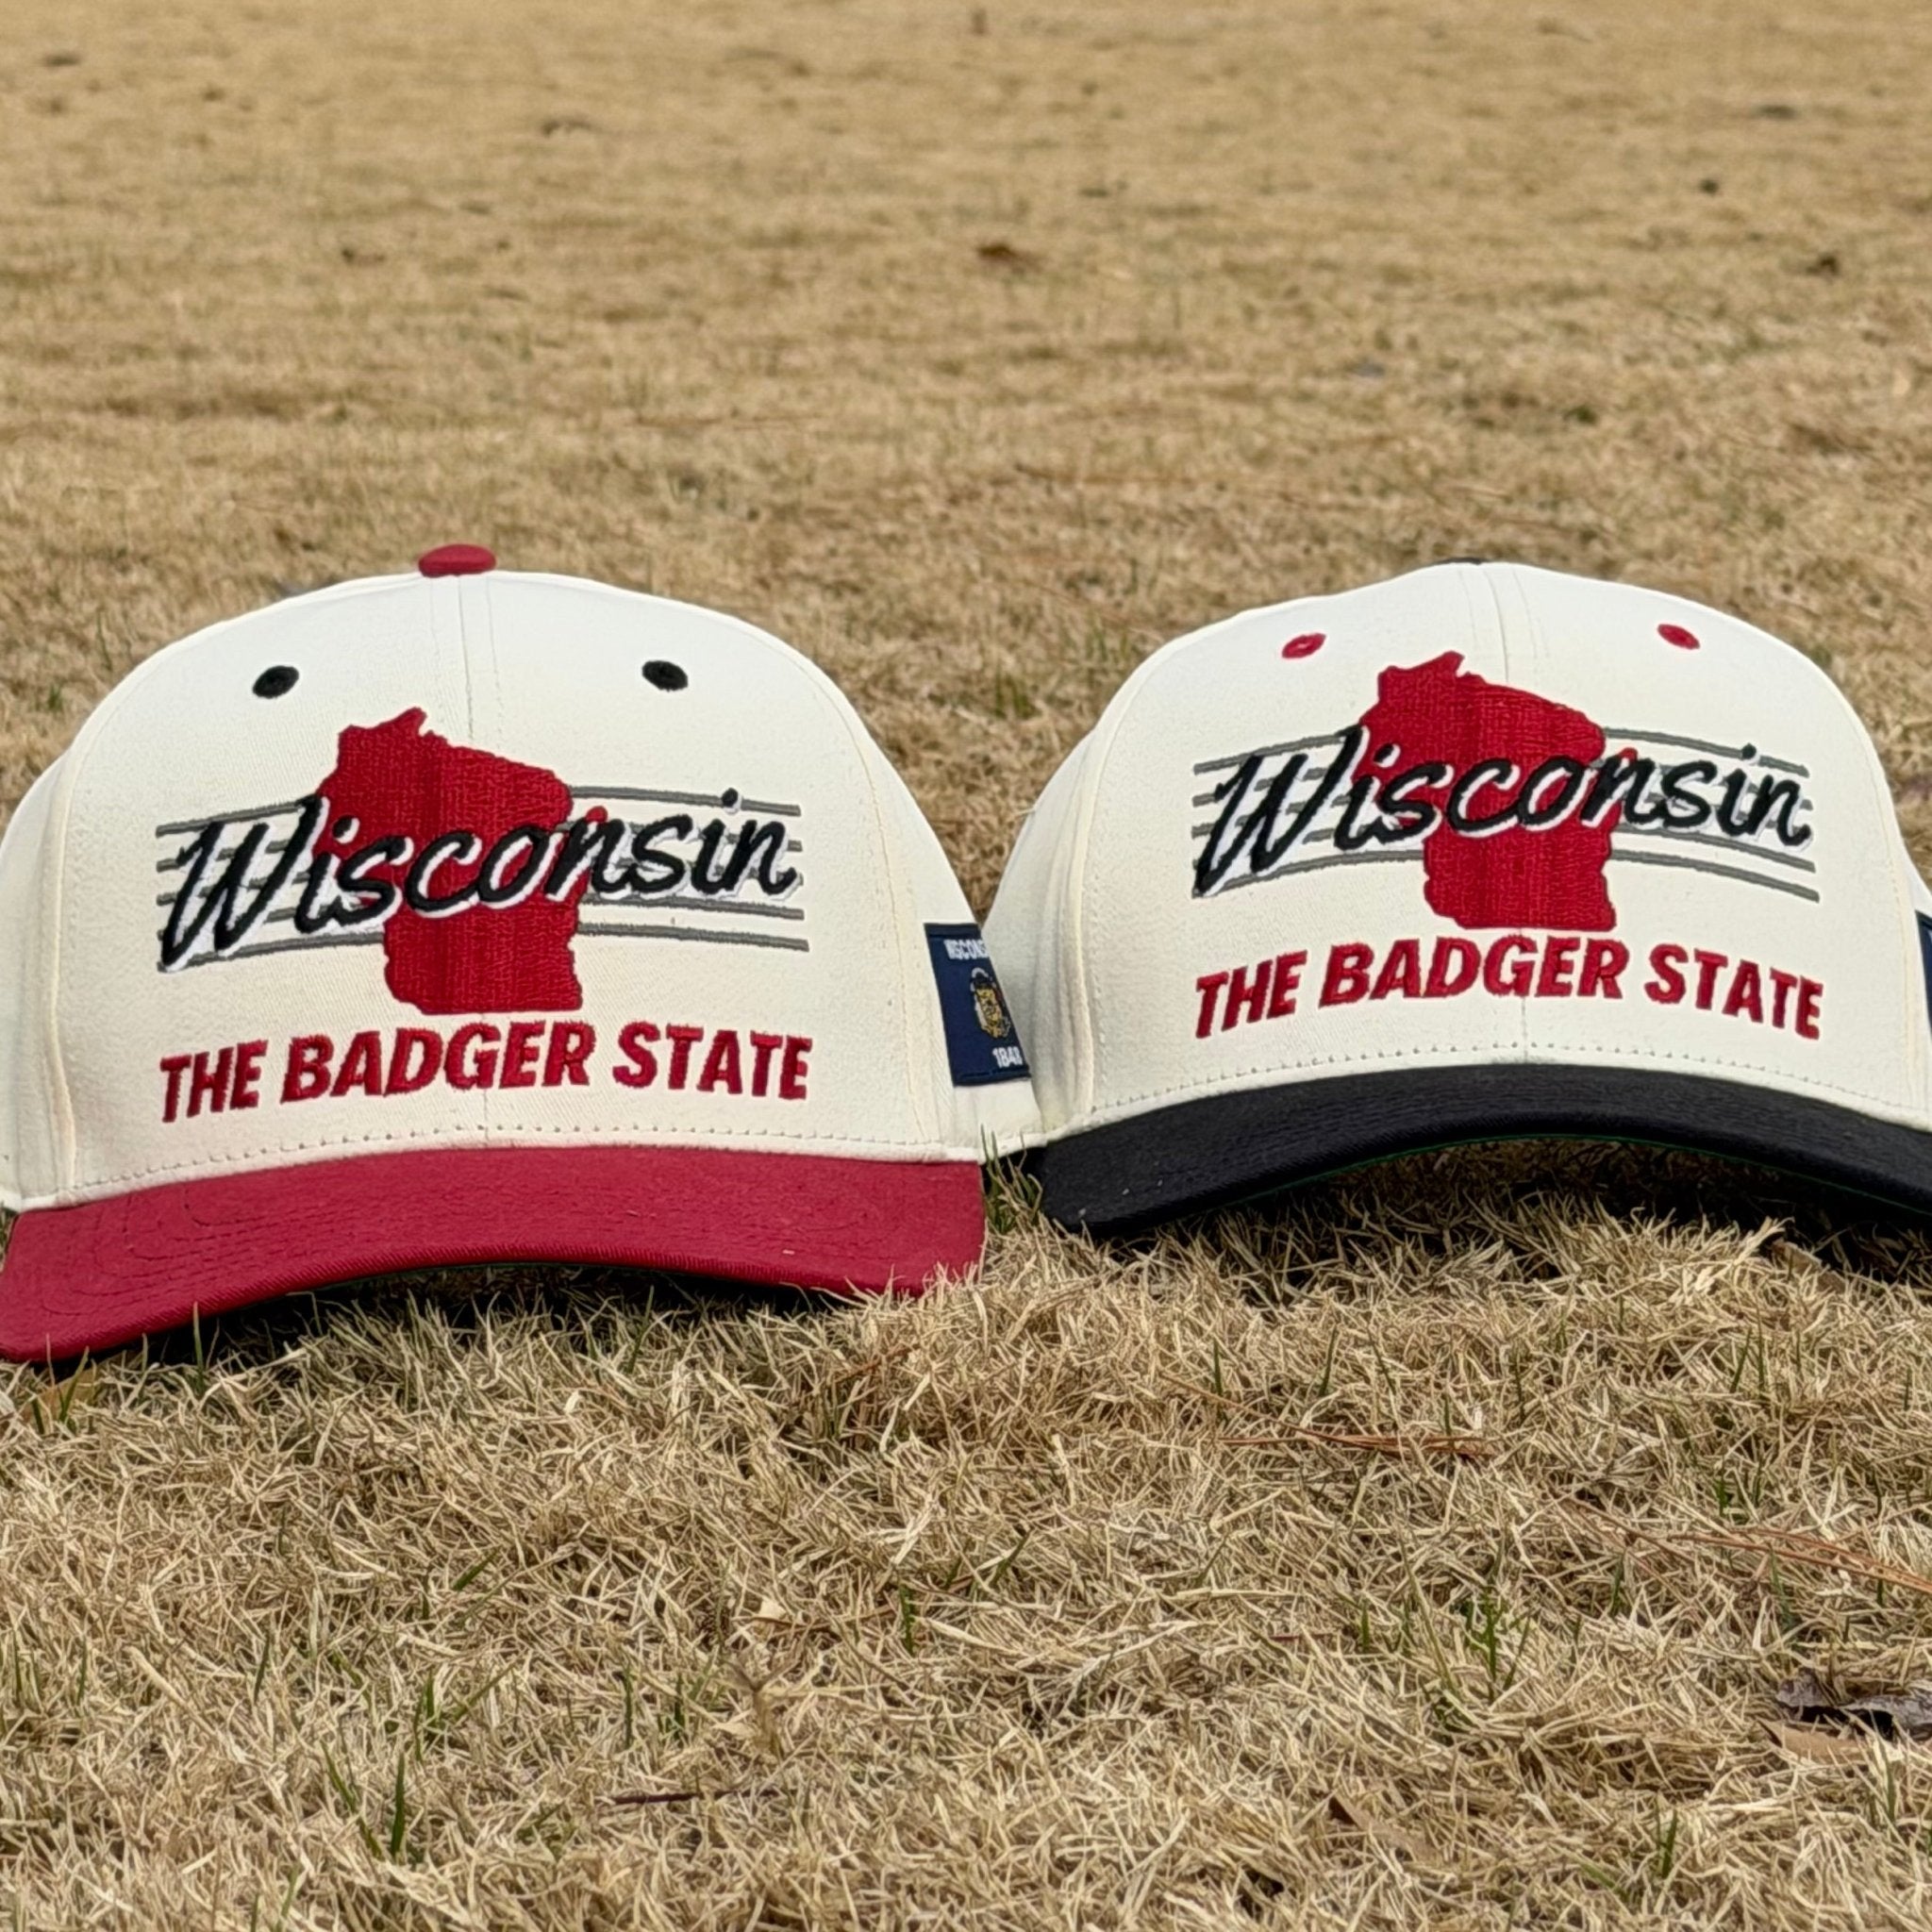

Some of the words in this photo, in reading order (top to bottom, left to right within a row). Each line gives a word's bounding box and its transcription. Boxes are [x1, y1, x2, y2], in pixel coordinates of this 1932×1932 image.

[1193, 724, 1811, 896] Wisconsin
[161, 789, 801, 972] Wisconsin
[1195, 949, 1307, 1039] THE
[1319, 935, 1629, 1008] BADGER
[1644, 942, 1823, 1040] STATE
[160, 1041, 268, 1122] THE
[280, 1021, 597, 1103] BADGER
[612, 1022, 812, 1100] STATE
